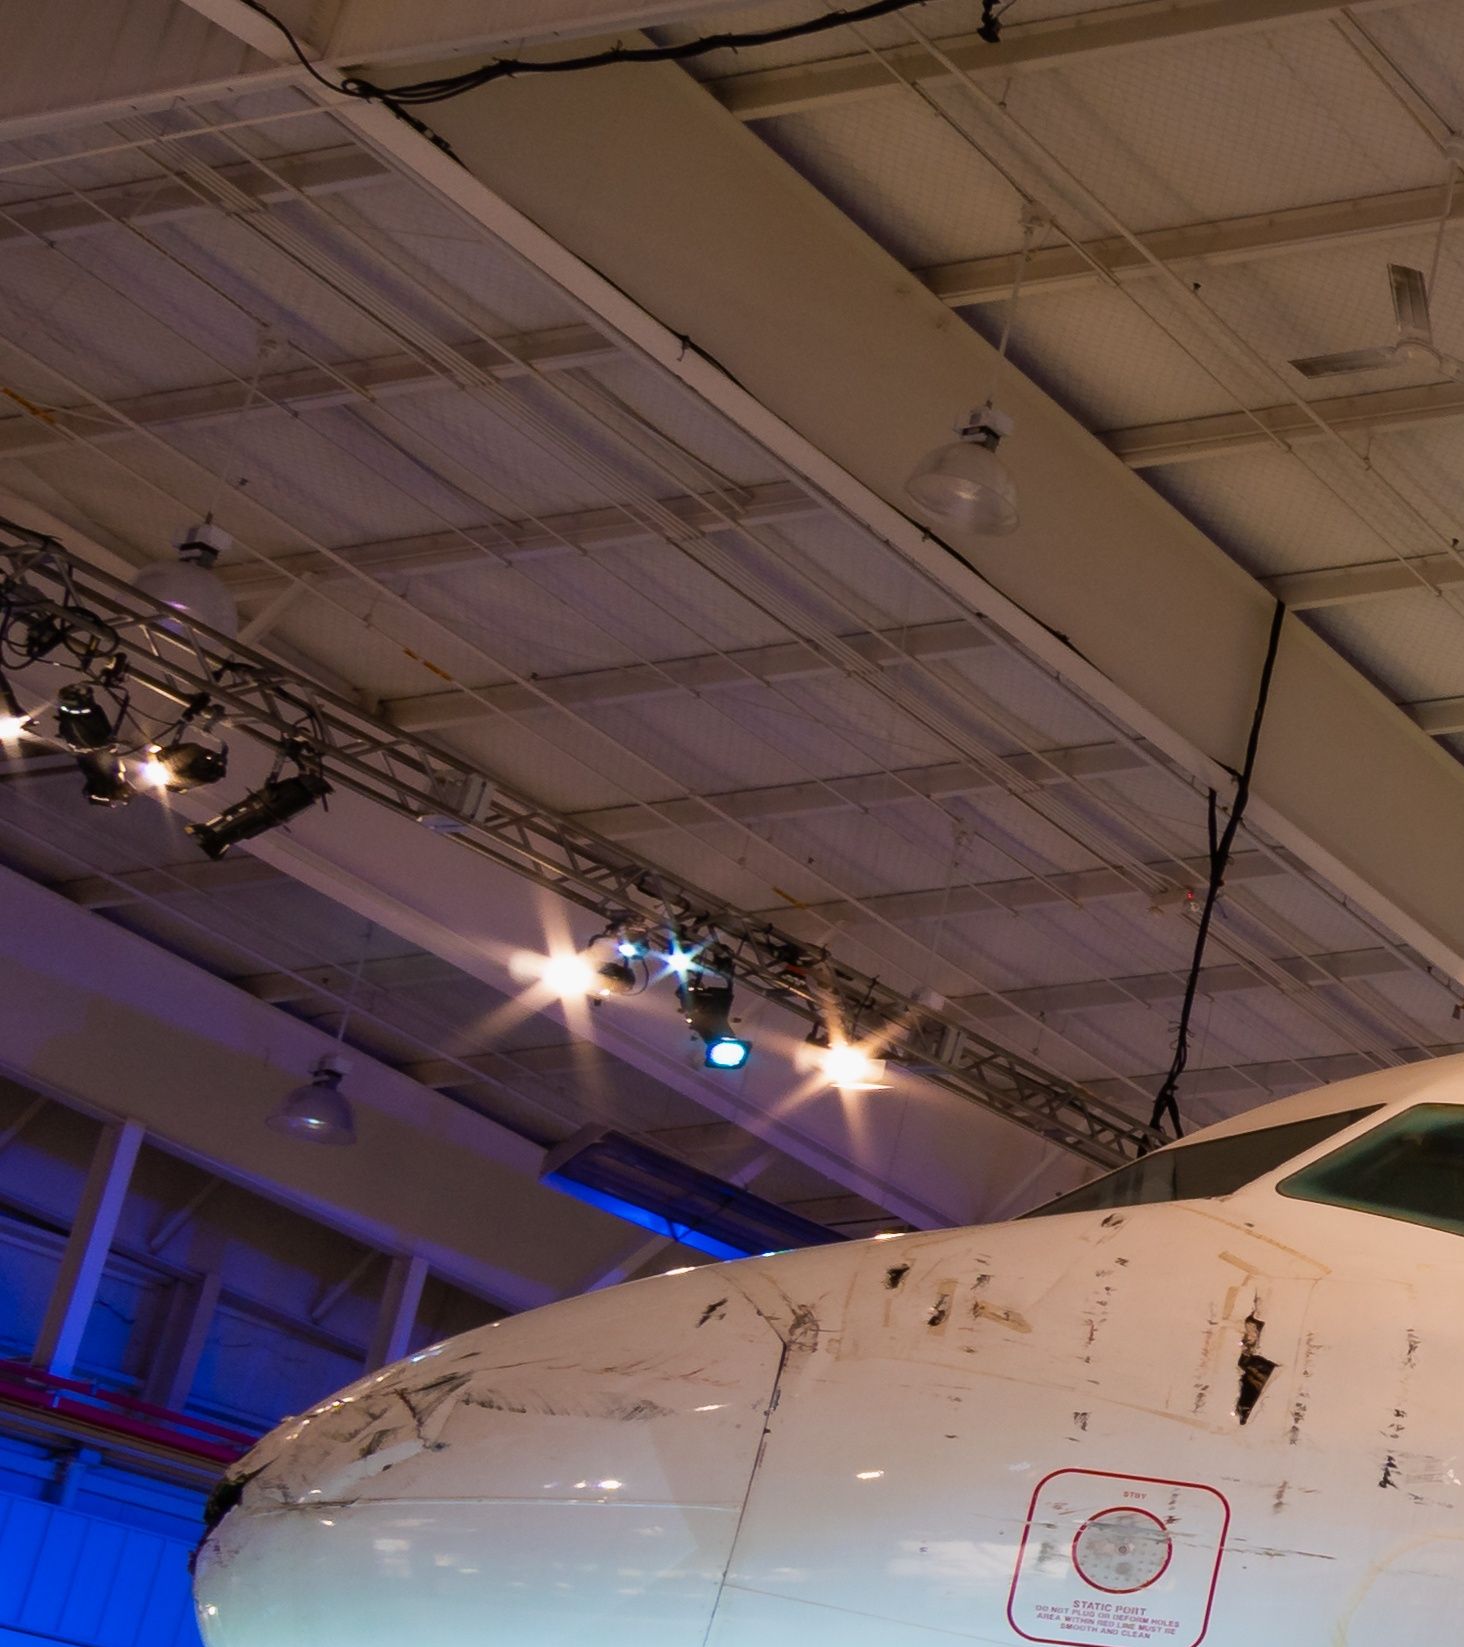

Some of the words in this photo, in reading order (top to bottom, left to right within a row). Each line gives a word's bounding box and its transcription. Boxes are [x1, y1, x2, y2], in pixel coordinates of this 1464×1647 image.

[1123, 1490, 1147, 1500] STBY
[1035, 1604, 1049, 1612] DO
[1051, 1606, 1070, 1615] NOT
[1071, 1608, 1095, 1618] PLUG
[1098, 1611, 1111, 1619] OR
[1113, 1612, 1149, 1624] DEFORM
[1151, 1618, 1180, 1628] HOLES
[1073, 1600, 1113, 1613] STATIC
[1116, 1605, 1147, 1616] PORT
[1036, 1612, 1062, 1622] AREA
[1064, 1615, 1095, 1625] WITHIN
[1097, 1619, 1114, 1627] RED
[1117, 1621, 1136, 1629] LINE
[1138, 1623, 1162, 1632] MUST
[1164, 1626, 1176, 1635] BE
[1060, 1623, 1098, 1633] SMOOTH
[1100, 1627, 1118, 1635] AND
[1121, 1629, 1151, 1639] CLEAN
